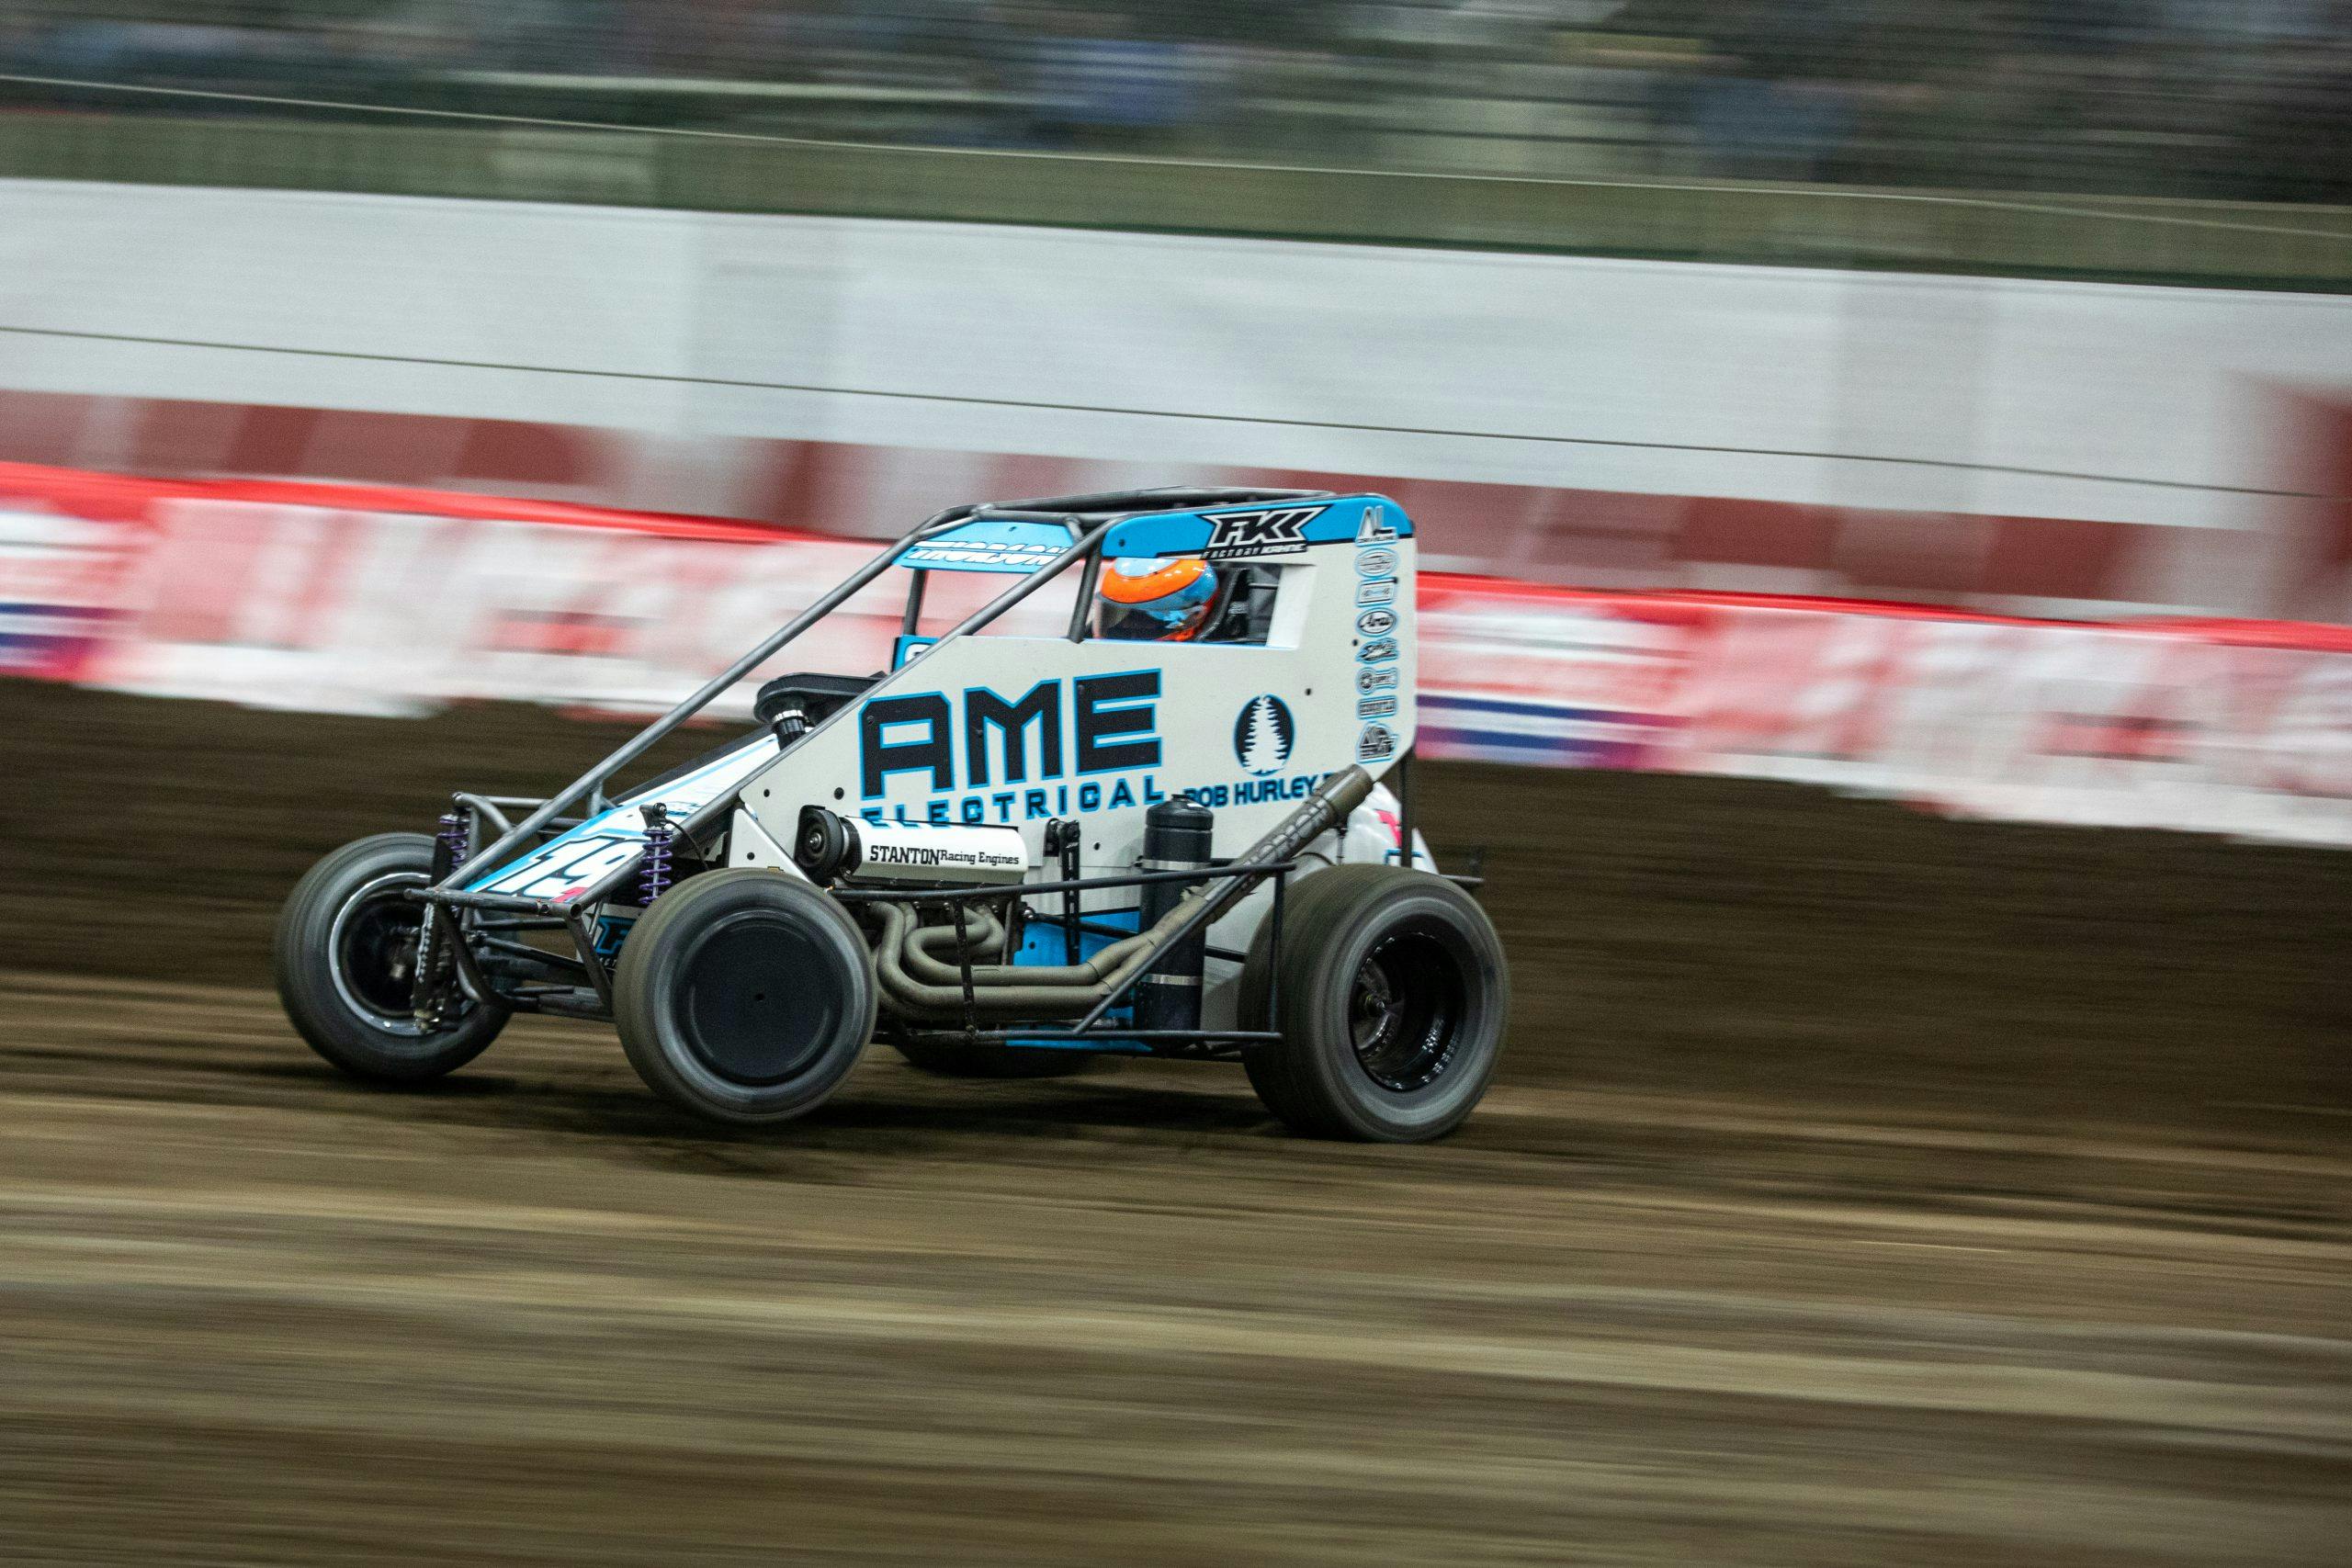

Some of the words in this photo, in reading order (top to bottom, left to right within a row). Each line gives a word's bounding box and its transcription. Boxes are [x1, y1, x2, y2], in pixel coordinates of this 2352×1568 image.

[859, 668, 1162, 799] AME
[860, 775, 1164, 828] ELECTRICAL
[1234, 774, 1317, 806] HURLEY
[869, 844, 940, 865] STANTON
[940, 851, 977, 865] Racing
[978, 852, 1020, 866] Engines
